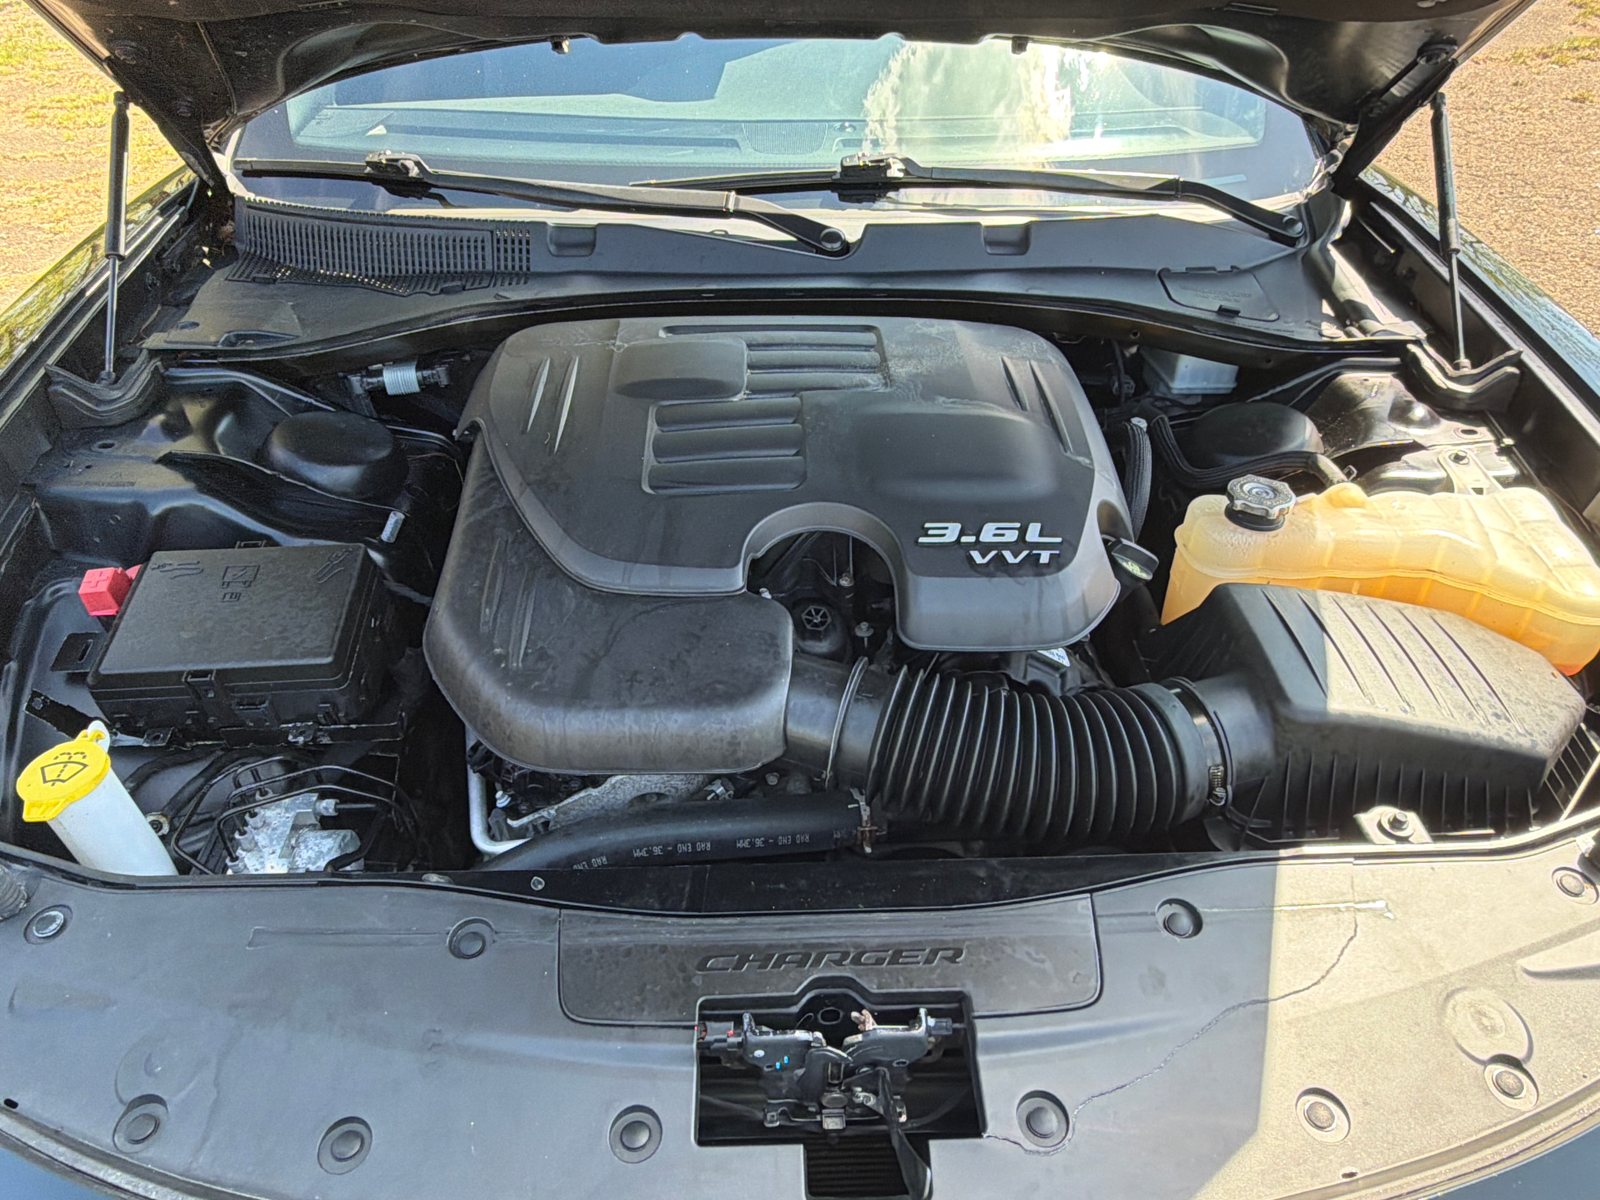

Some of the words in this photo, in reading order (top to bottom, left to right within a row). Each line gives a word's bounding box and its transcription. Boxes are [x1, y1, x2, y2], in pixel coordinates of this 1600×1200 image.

[917, 522, 1063, 543] 3.6L
[968, 550, 1061, 565] VVT
[777, 835, 792, 846] END
[795, 833, 810, 844] RAD
[676, 843, 692, 853] END
[696, 841, 711, 851] RAD
[591, 855, 607, 868] RAD
[696, 944, 966, 973] CHARGER
